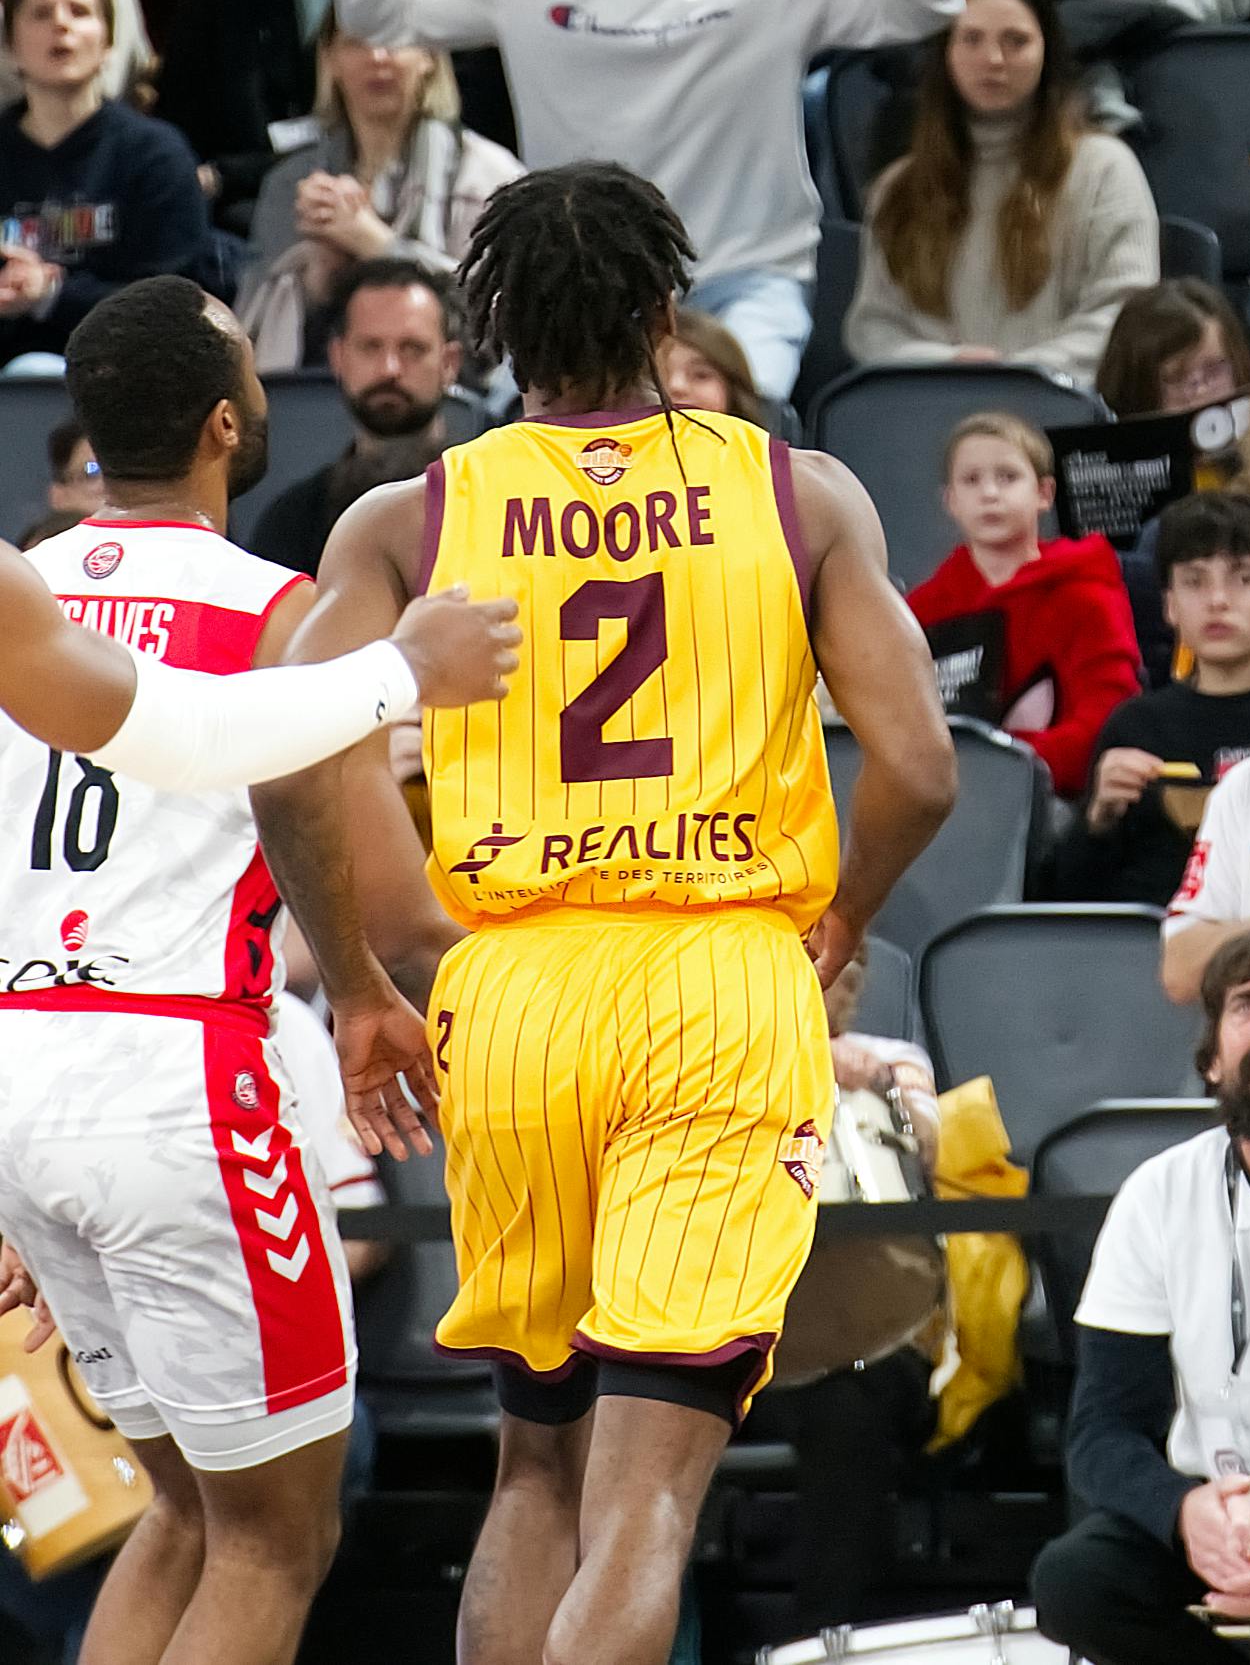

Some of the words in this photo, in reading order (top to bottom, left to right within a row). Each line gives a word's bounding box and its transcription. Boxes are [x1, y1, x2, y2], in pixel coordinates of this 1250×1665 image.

[502, 485, 715, 562] MOORE
[560, 571, 674, 783] 2
[618, 869, 654, 881] DES
[662, 861, 768, 884] TERRITOIRES
[436, 1009, 455, 1075] 2
